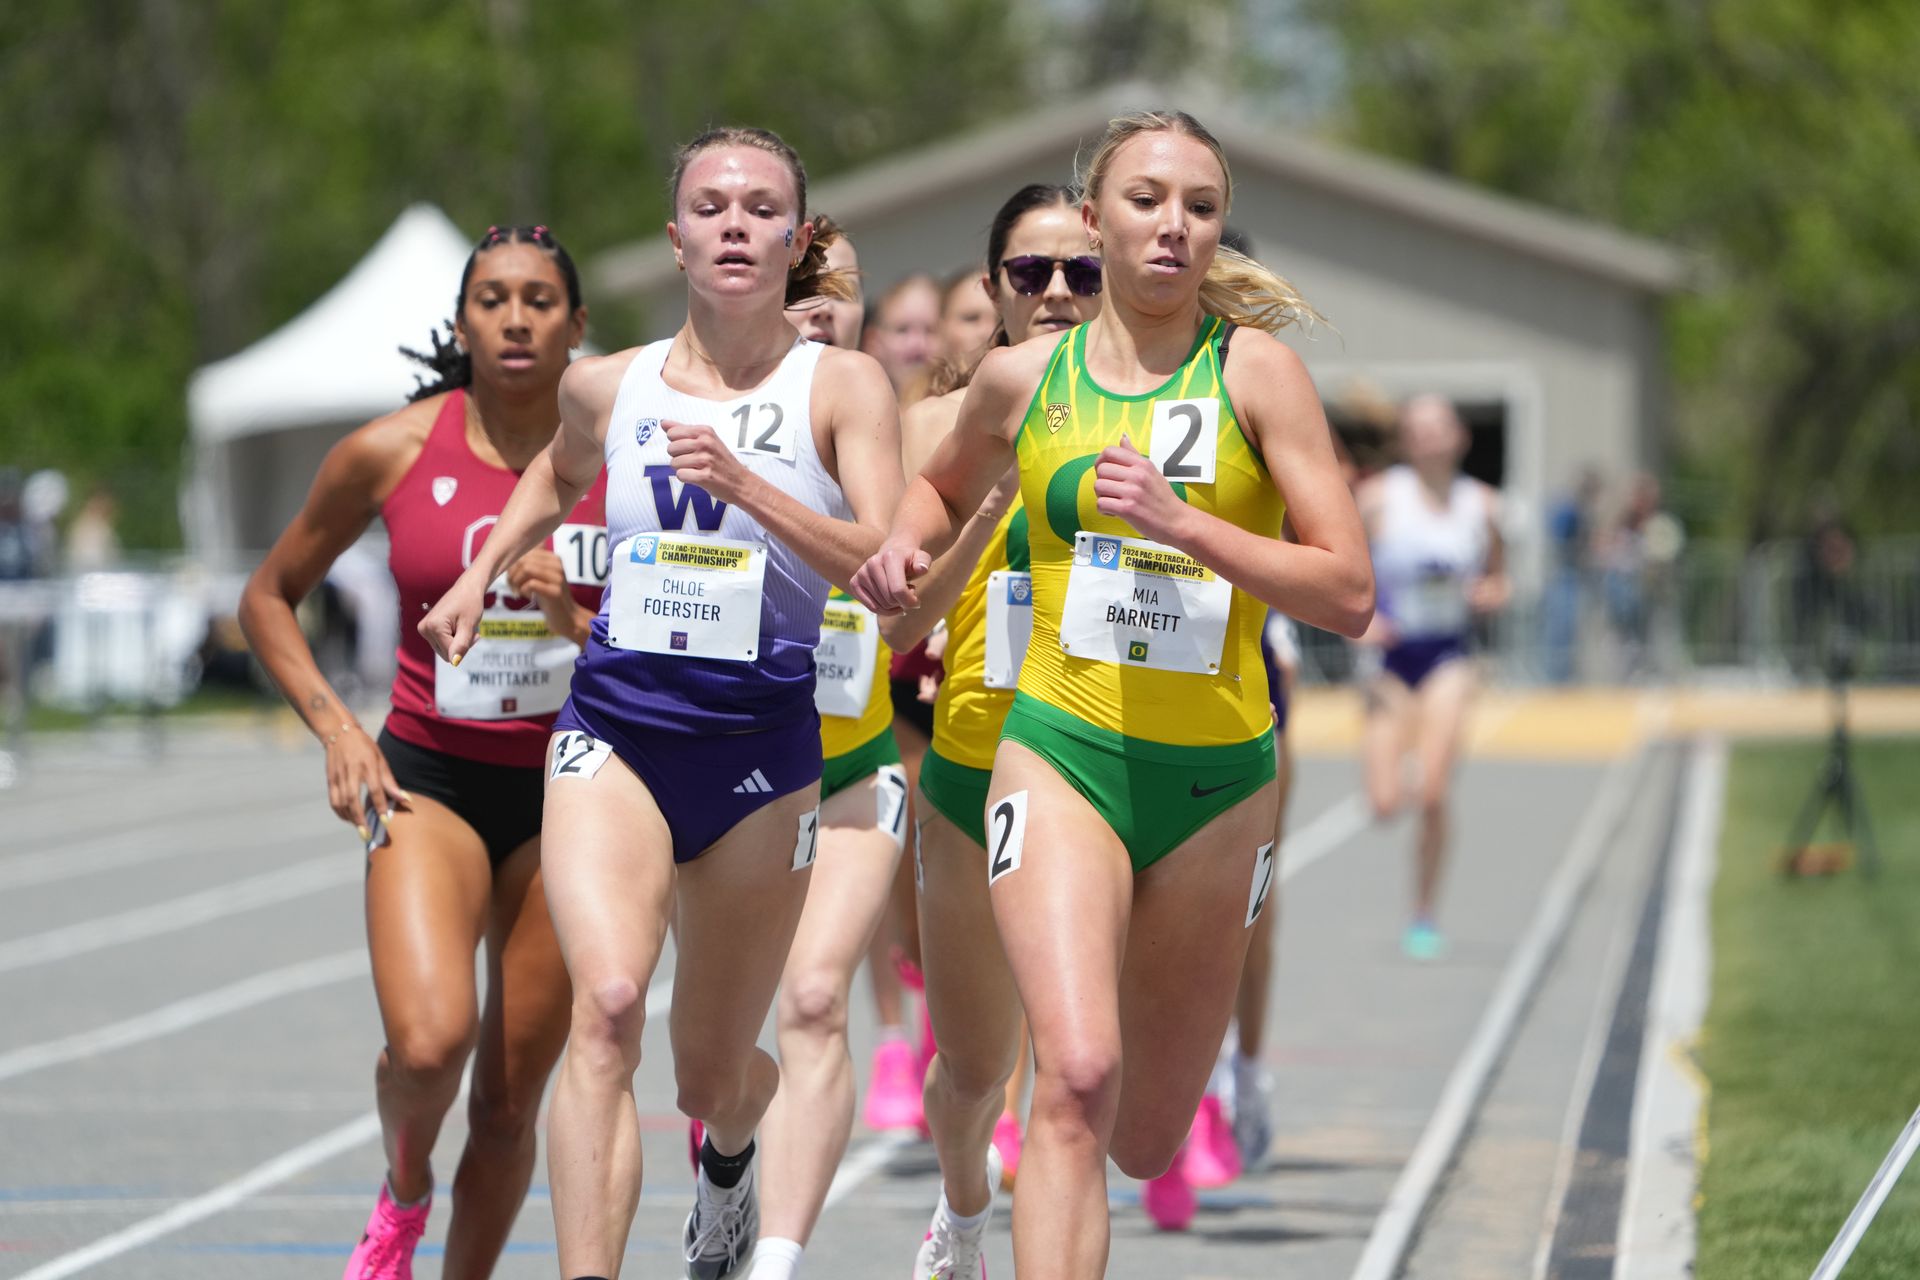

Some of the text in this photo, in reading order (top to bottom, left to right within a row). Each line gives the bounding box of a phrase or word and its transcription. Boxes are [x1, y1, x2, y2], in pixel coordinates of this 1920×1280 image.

[1047, 403, 1071, 421] PAC
[1050, 416, 1062, 428] 12
[732, 402, 784, 454] 12
[1163, 403, 1202, 477] 2
[643, 465, 728, 531] W
[569, 530, 609, 582] 10
[659, 543, 675, 551] 2024
[675, 545, 697, 554] PAC-12
[698, 547, 719, 556] TRACK
[726, 550, 743, 559] FIELD
[661, 551, 738, 568] CHAMPIONSHIPS
[1122, 547, 1139, 557] 2024
[1139, 549, 1163, 561] PAC-12
[1164, 554, 1185, 565] TRACK
[1186, 557, 1192, 565] &
[1125, 556, 1204, 578] CHAMPIONSHIPS
[662, 578, 705, 597] CHLOE
[1132, 587, 1159, 606] MIA
[644, 598, 721, 622] FOERSTER
[1106, 605, 1181, 632] BARNETT
[1131, 645, 1146, 657] O
[468, 670, 550, 687] WHITTAKER
[552, 734, 595, 777] 12
[806, 813, 817, 864] 1
[991, 801, 1014, 880] 2
